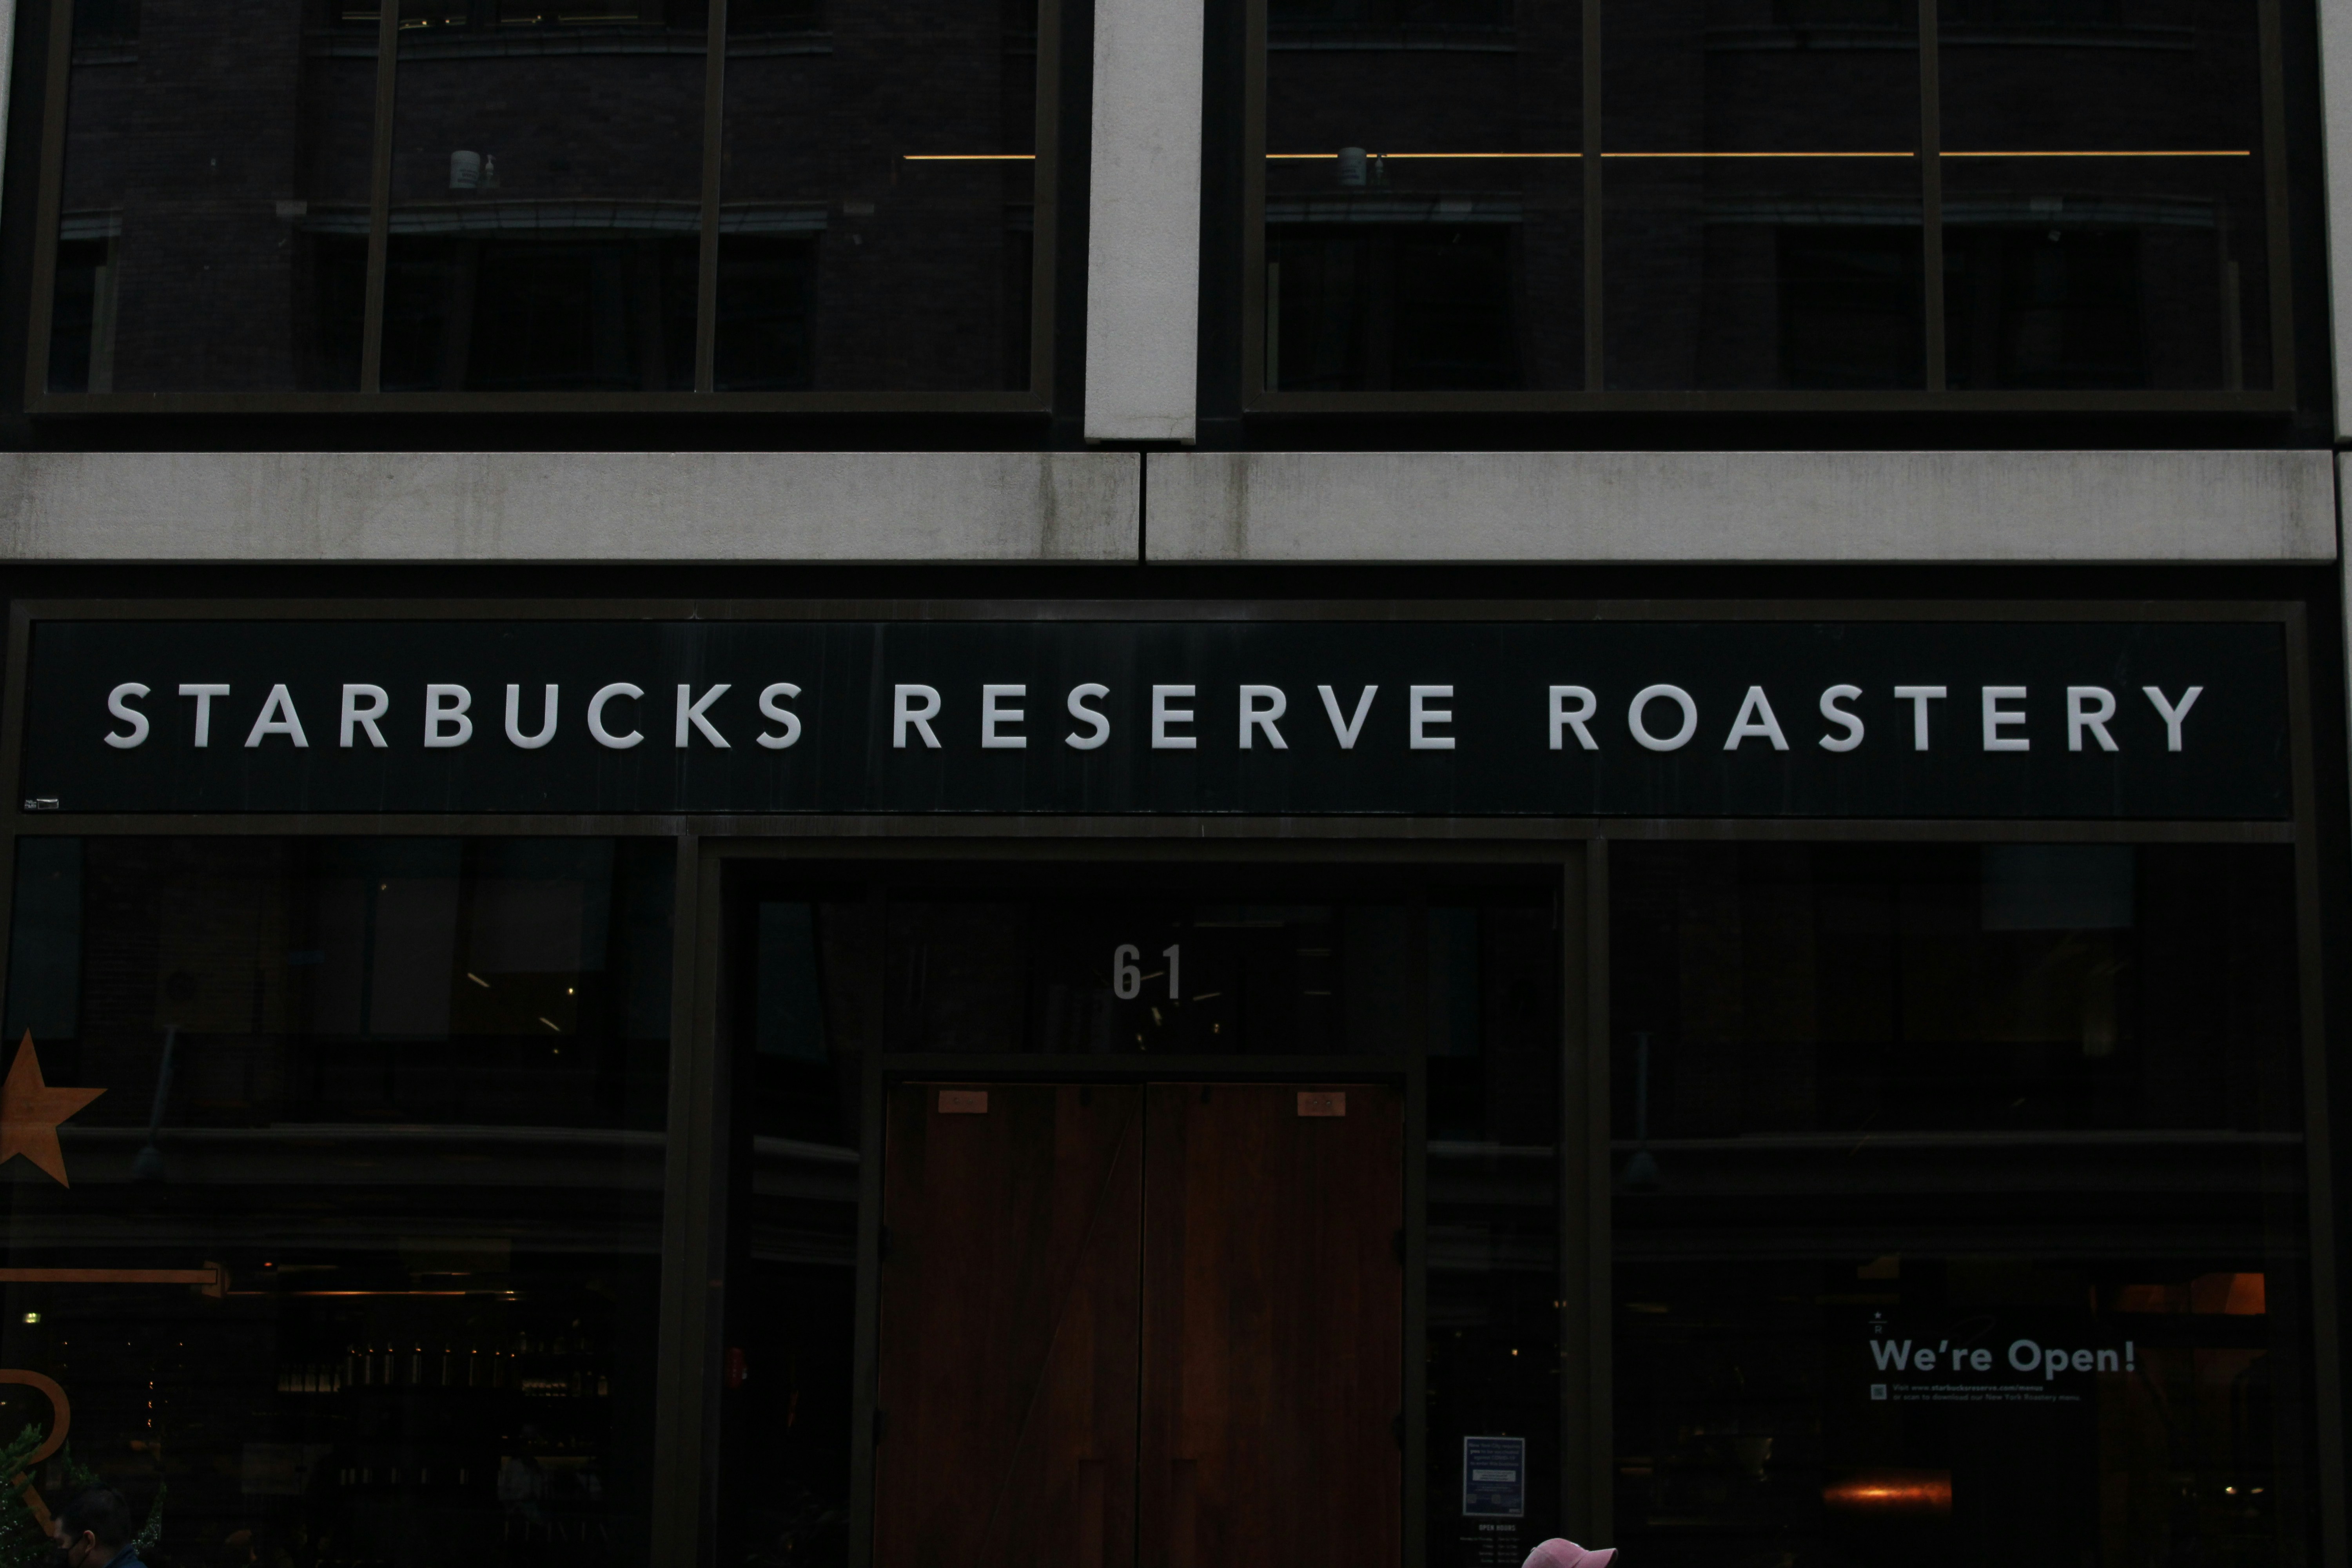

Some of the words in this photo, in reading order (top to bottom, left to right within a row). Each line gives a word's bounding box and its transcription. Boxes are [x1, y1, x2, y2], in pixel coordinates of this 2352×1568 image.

[104, 682, 804, 750] STARBUCKS
[893, 683, 1457, 750] RESERVE
[1548, 684, 2203, 752] ROASTERY
[1113, 943, 1180, 1000] 61
[1870, 1339, 1993, 1371] We're
[2007, 1339, 2136, 1381] Open!
